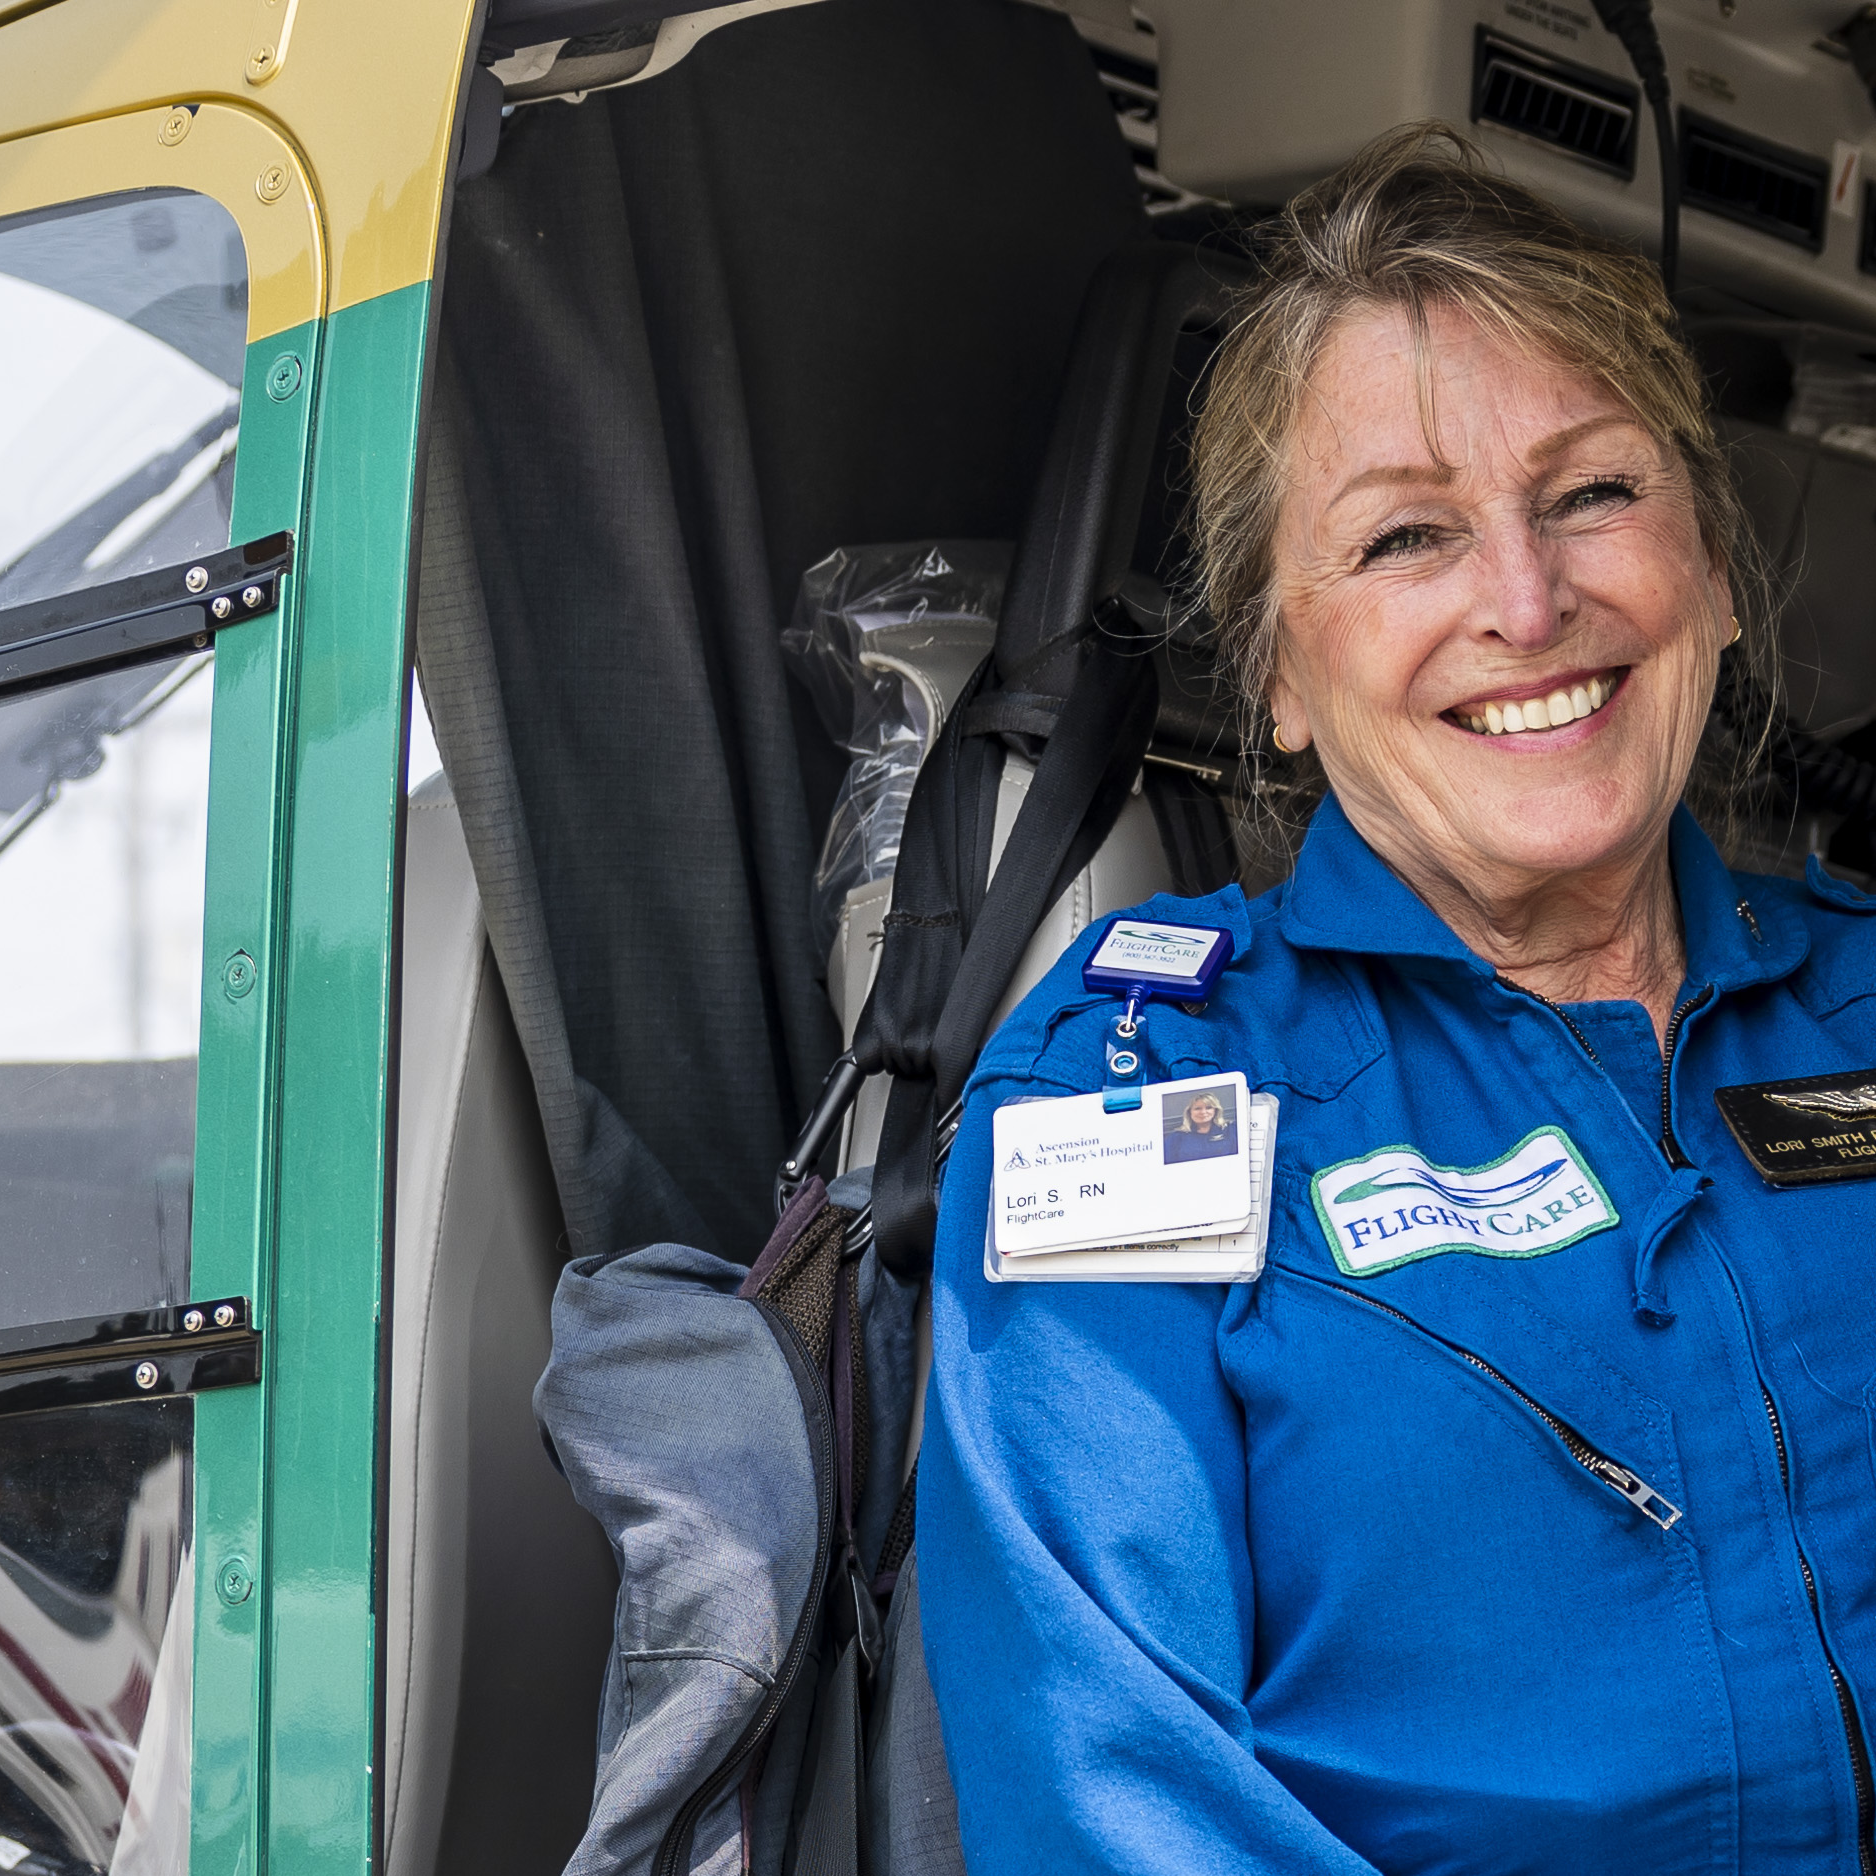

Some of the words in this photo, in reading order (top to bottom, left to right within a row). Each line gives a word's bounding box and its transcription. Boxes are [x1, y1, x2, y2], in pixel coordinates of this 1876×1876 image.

[1036, 1137, 1100, 1154] Ascension
[1766, 1138, 1806, 1154] LORI
[1811, 1131, 1867, 1148] SMITH
[1035, 1156, 1052, 1168] St.
[1055, 1149, 1097, 1164] Mary's
[1100, 1140, 1153, 1157] Hospital
[1007, 1192, 1037, 1209] Lori
[1047, 1189, 1063, 1203] S.
[1079, 1182, 1106, 1198] RN
[1006, 1208, 1065, 1225] FlightCare
[1146, 1243, 1180, 1253] correctly
